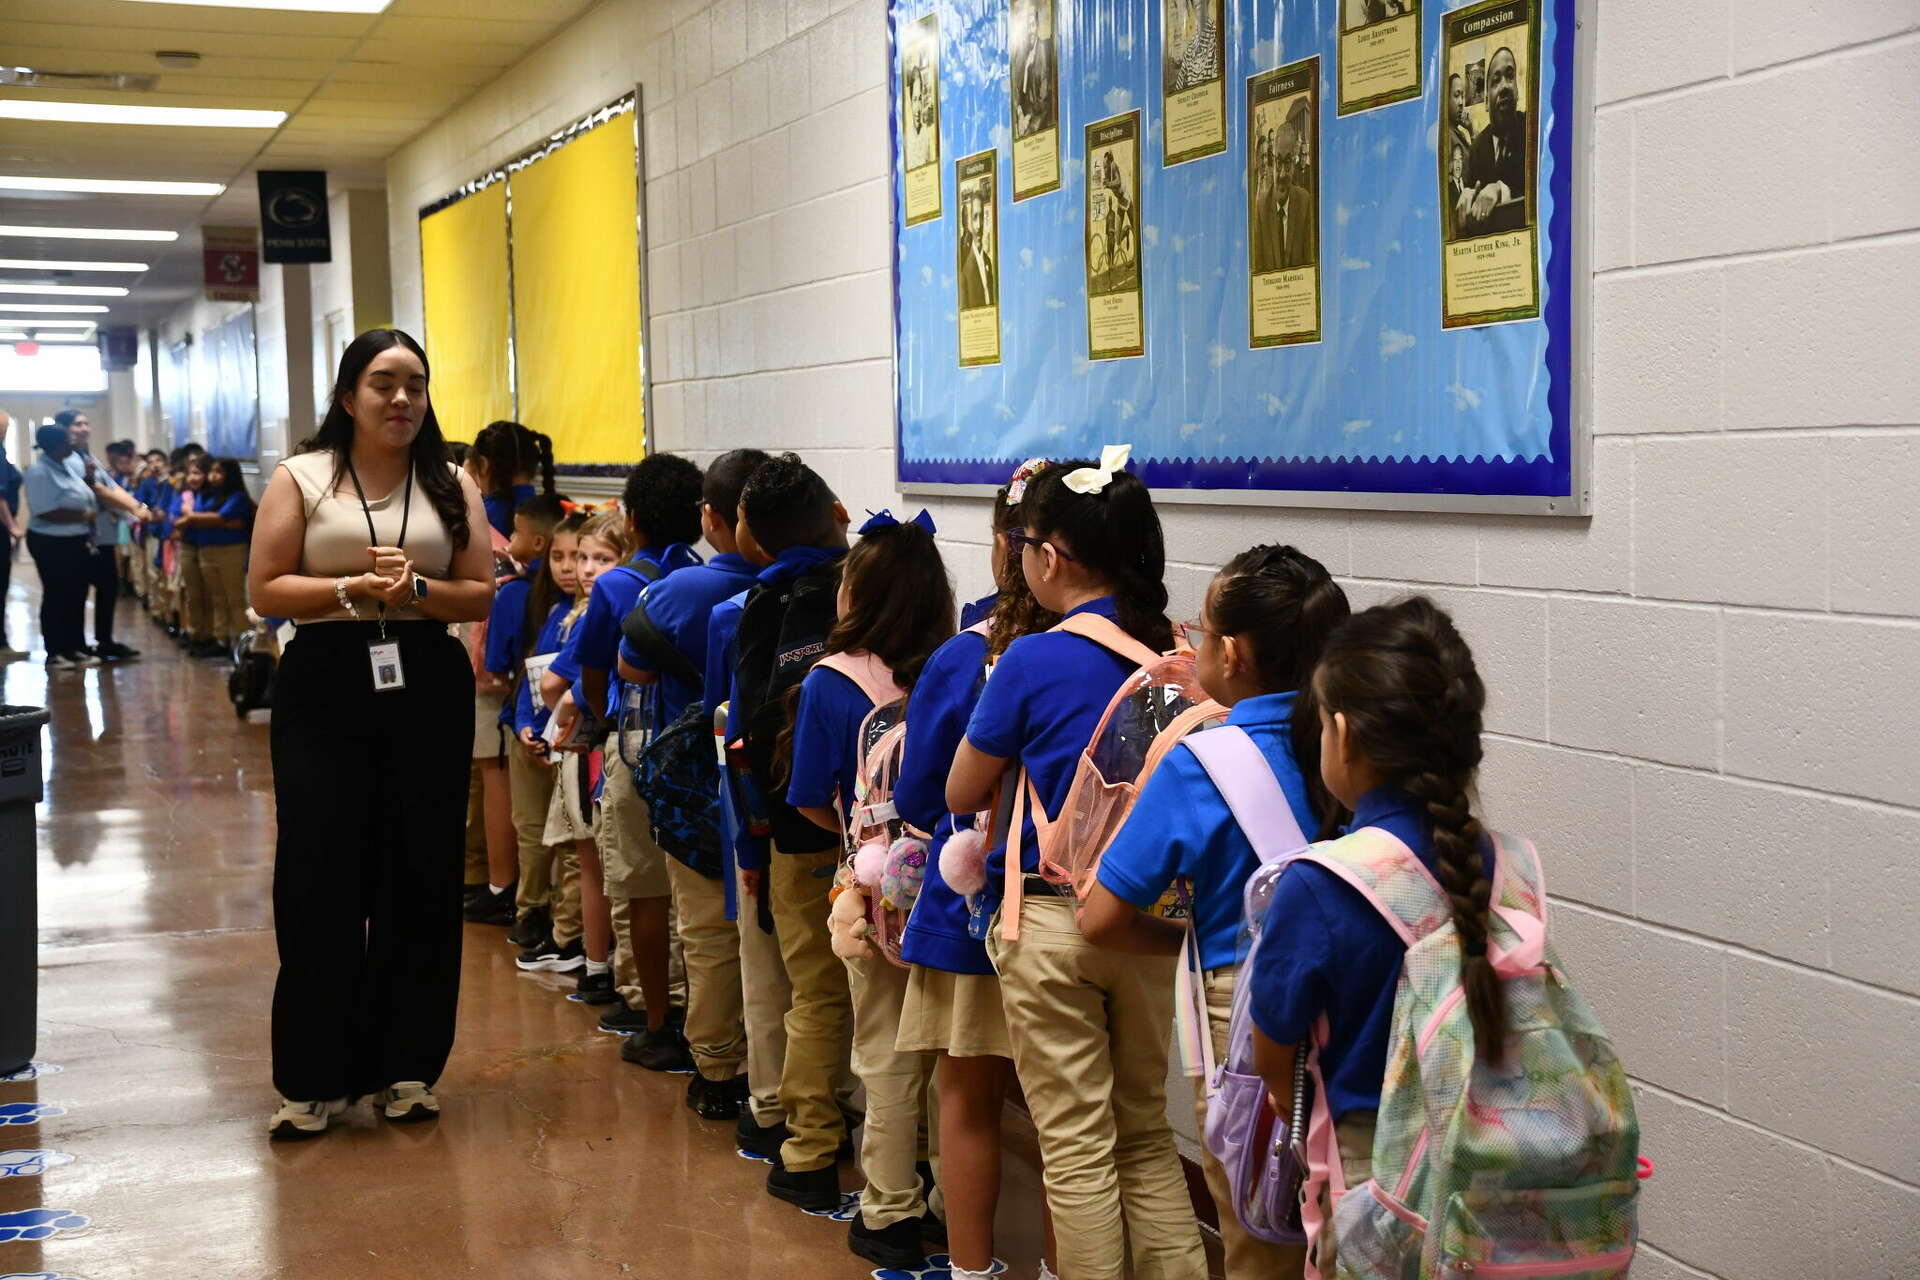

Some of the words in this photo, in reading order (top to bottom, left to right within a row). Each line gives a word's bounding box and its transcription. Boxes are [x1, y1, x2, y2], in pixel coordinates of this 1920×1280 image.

[1463, 9, 1514, 34] Compassion
[1268, 80, 1295, 94] Fairness
[779, 642, 825, 667] JANSPORT
